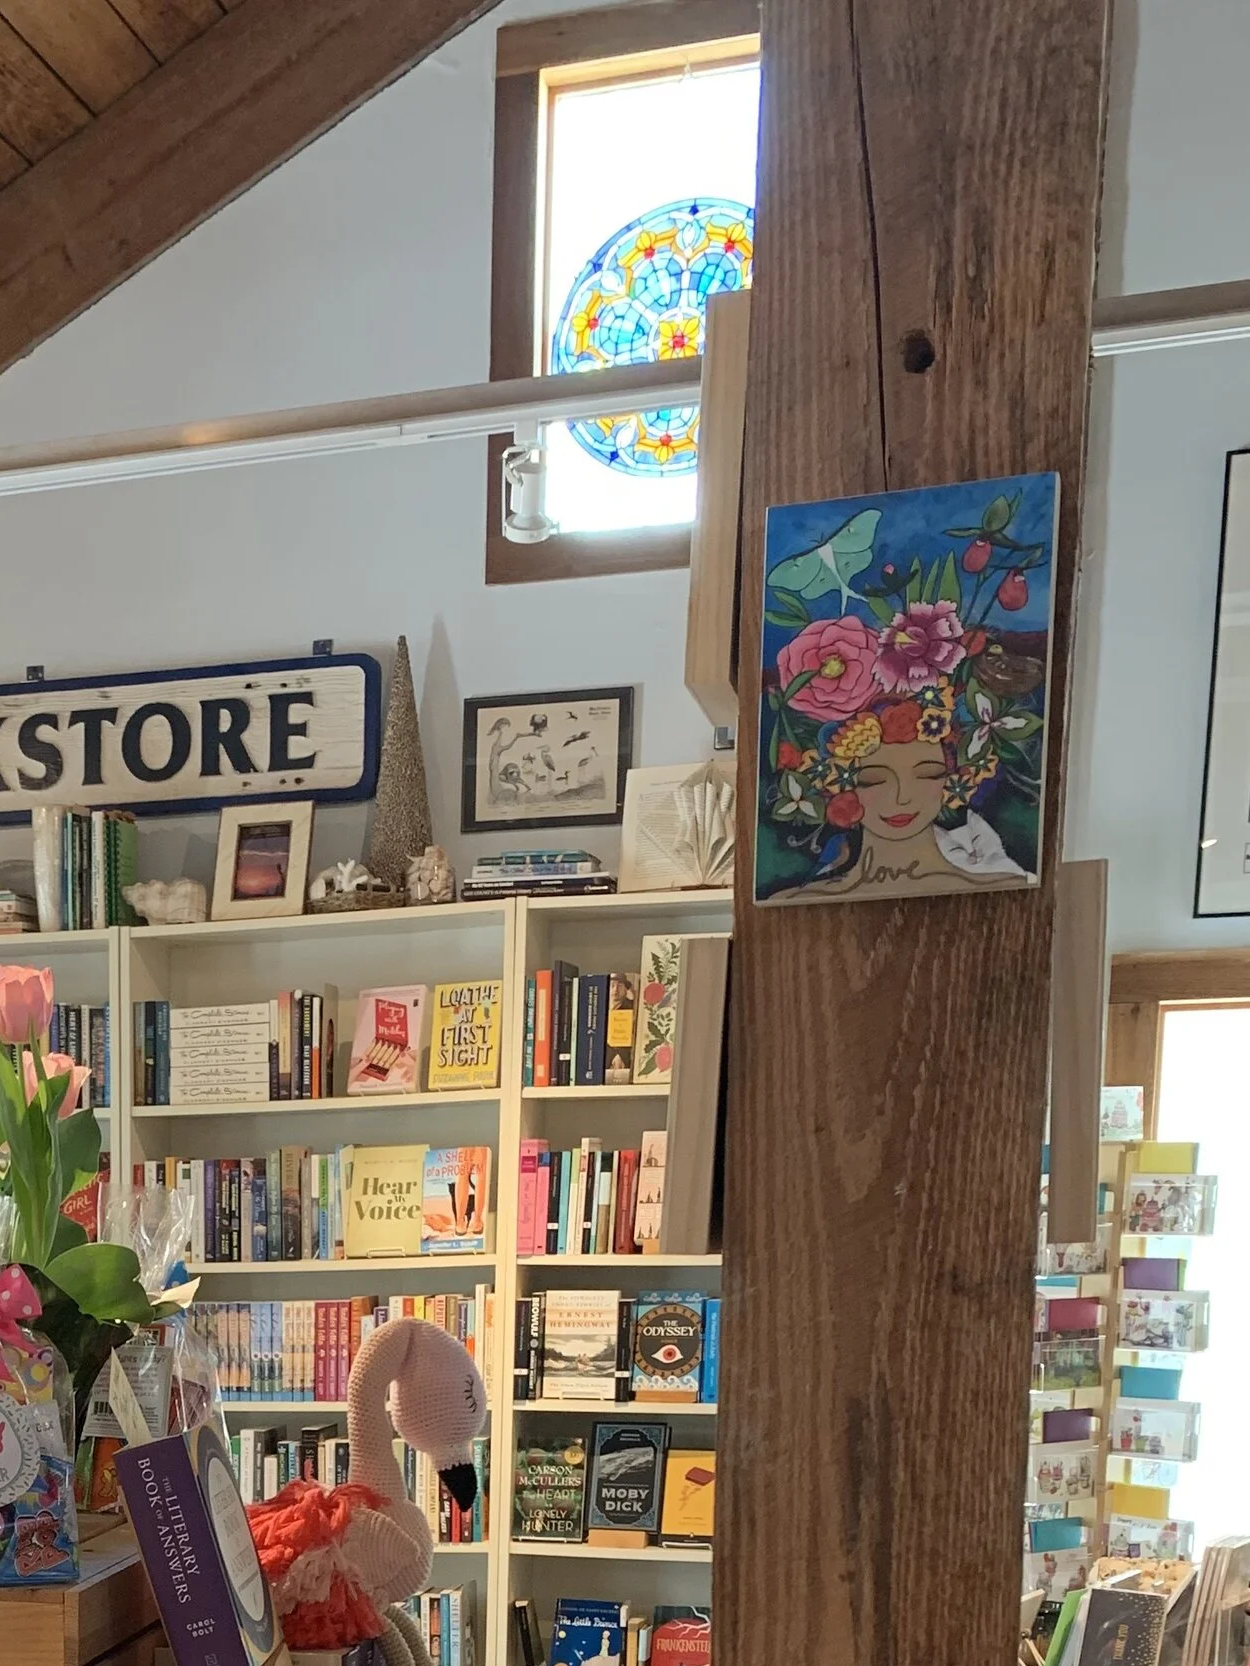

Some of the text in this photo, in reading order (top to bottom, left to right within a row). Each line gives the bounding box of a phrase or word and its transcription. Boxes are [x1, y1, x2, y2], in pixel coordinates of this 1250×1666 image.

[859, 846, 920, 884] love
[460, 1007, 477, 1024] AT
[441, 1025, 492, 1046] FIRST
[438, 1045, 493, 1068] SIGHT
[362, 1177, 418, 1196] Hear
[354, 1199, 421, 1221] Voice
[531, 1297, 540, 1338] BEOWULF
[559, 1311, 605, 1319] ERNEST
[550, 1320, 614, 1329] HEMINGWAY
[643, 1326, 697, 1337] ODYSSEY
[528, 1464, 573, 1475] CARSON
[518, 1476, 582, 1488] McCULLERS
[537, 1488, 577, 1500] HEART
[601, 1487, 650, 1499] MOBY
[605, 1501, 643, 1512] DICK
[530, 1509, 567, 1519] LONELY
[137, 1457, 192, 1604] BOOK ANSWERS
[162, 1477, 200, 1576] THE LITERARY
[522, 1520, 574, 1532] HUNTER
[187, 1617, 216, 1630] CAROL
[192, 1627, 214, 1637] BOLT
[656, 1638, 710, 1653] FRANKENSTEI
